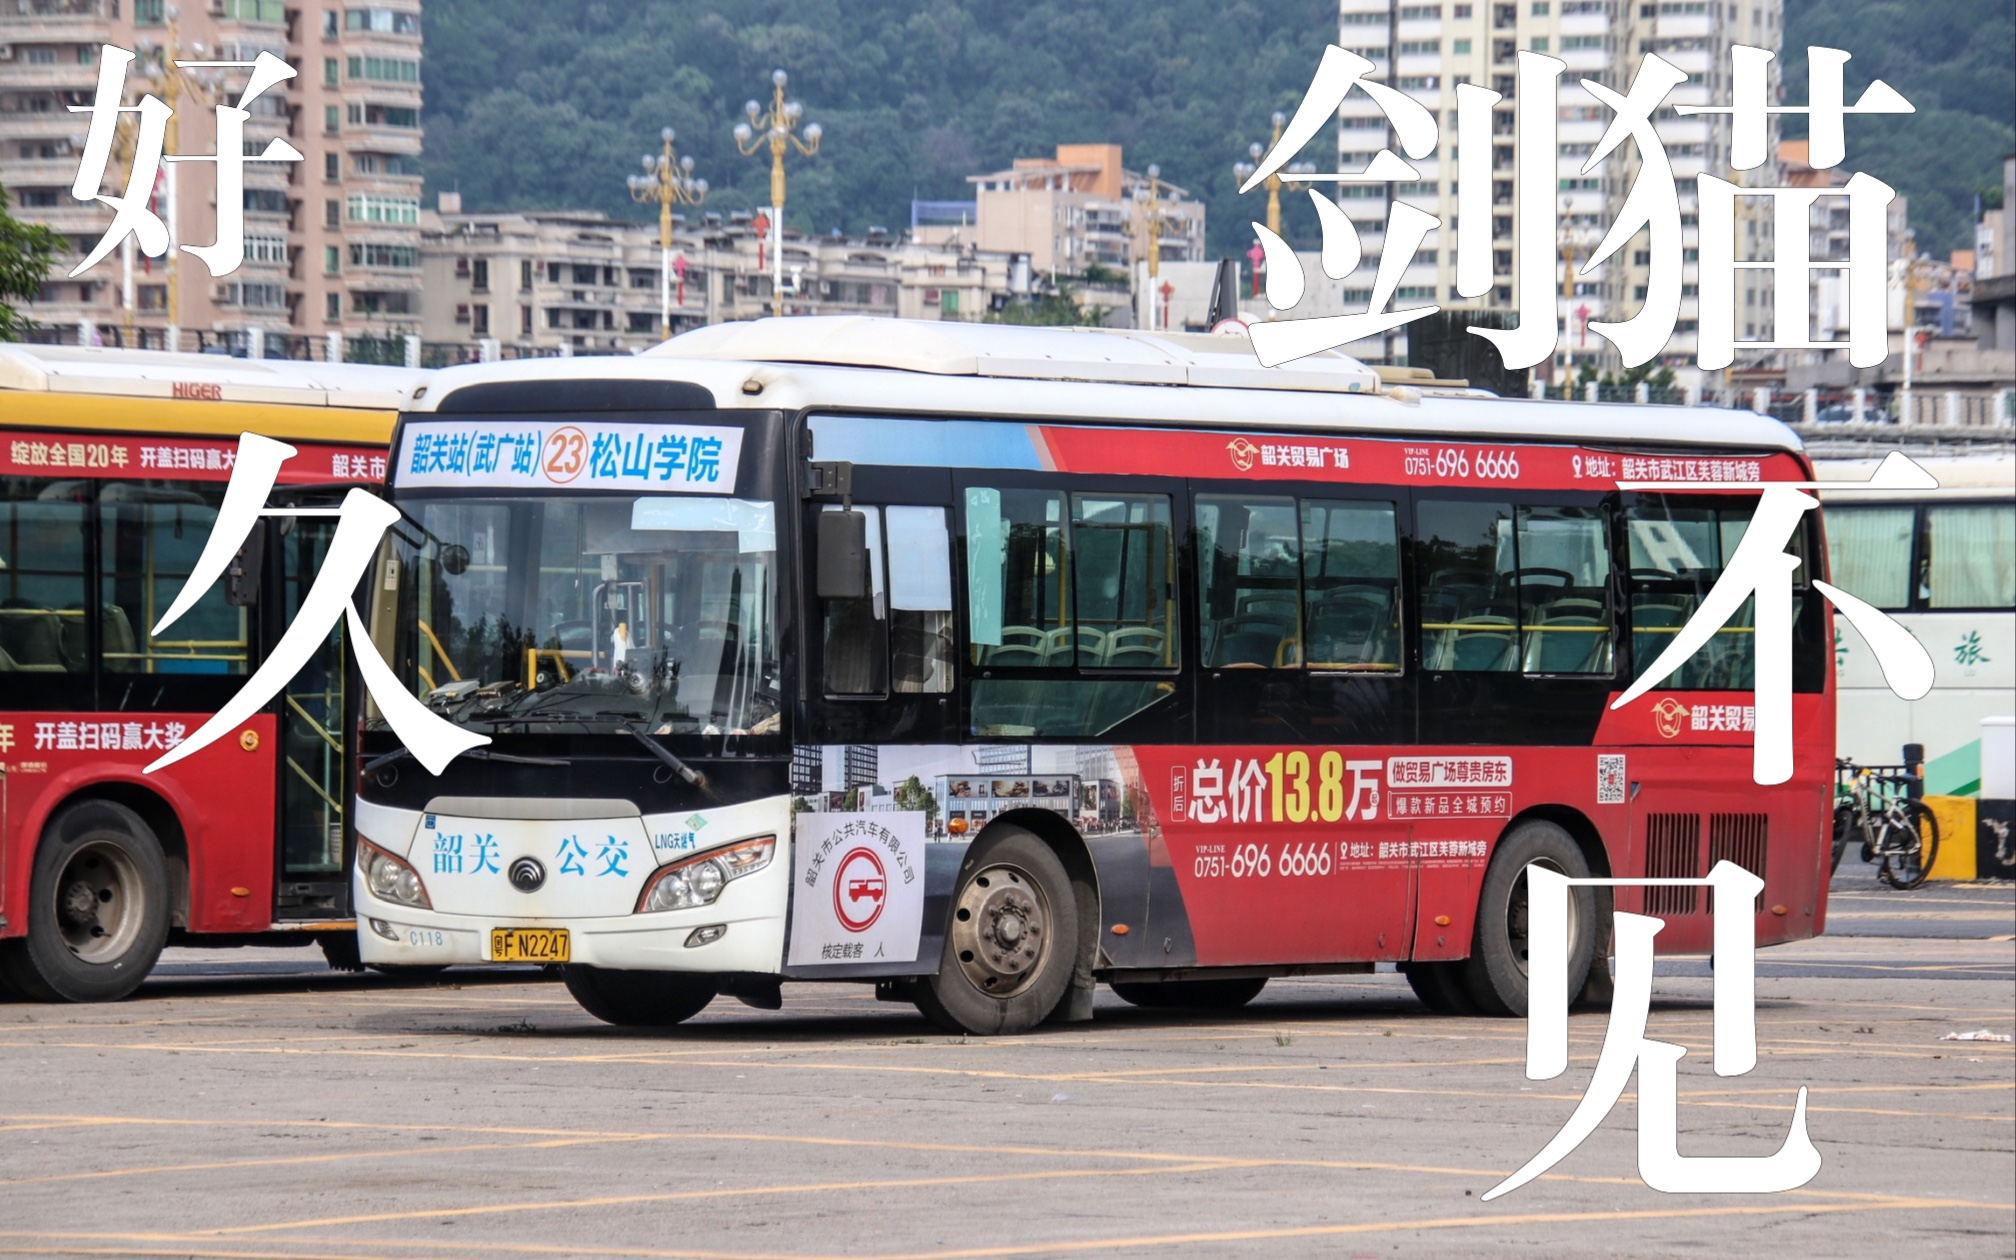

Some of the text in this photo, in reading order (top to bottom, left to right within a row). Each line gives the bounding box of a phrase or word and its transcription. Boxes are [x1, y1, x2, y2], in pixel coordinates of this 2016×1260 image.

[172, 382, 223, 400] HIGER
[11, 440, 129, 468] 绽放全国20年
[332, 453, 386, 479] 韶关市
[547, 433, 589, 474] 23
[590, 432, 723, 483] 松山学院
[1261, 444, 1350, 469] 韶关贸易广场
[1475, 450, 1520, 479] 6666
[34, 722, 187, 751] 开盖扫码赢大奖
[1392, 761, 1507, 784] 做贸易广场尊贵房东
[1173, 775, 1185, 813] 折后
[1396, 796, 1506, 815] 爆款新品全城预约
[432, 831, 630, 878] 韶关 公交
[805, 819, 916, 887] 韶关市公共汽车有限公司
[1196, 844, 1226, 854] VIP-LINE
[1279, 842, 1331, 877] 6666
[410, 931, 443, 946] C118
[821, 942, 864, 959] 核定载客
